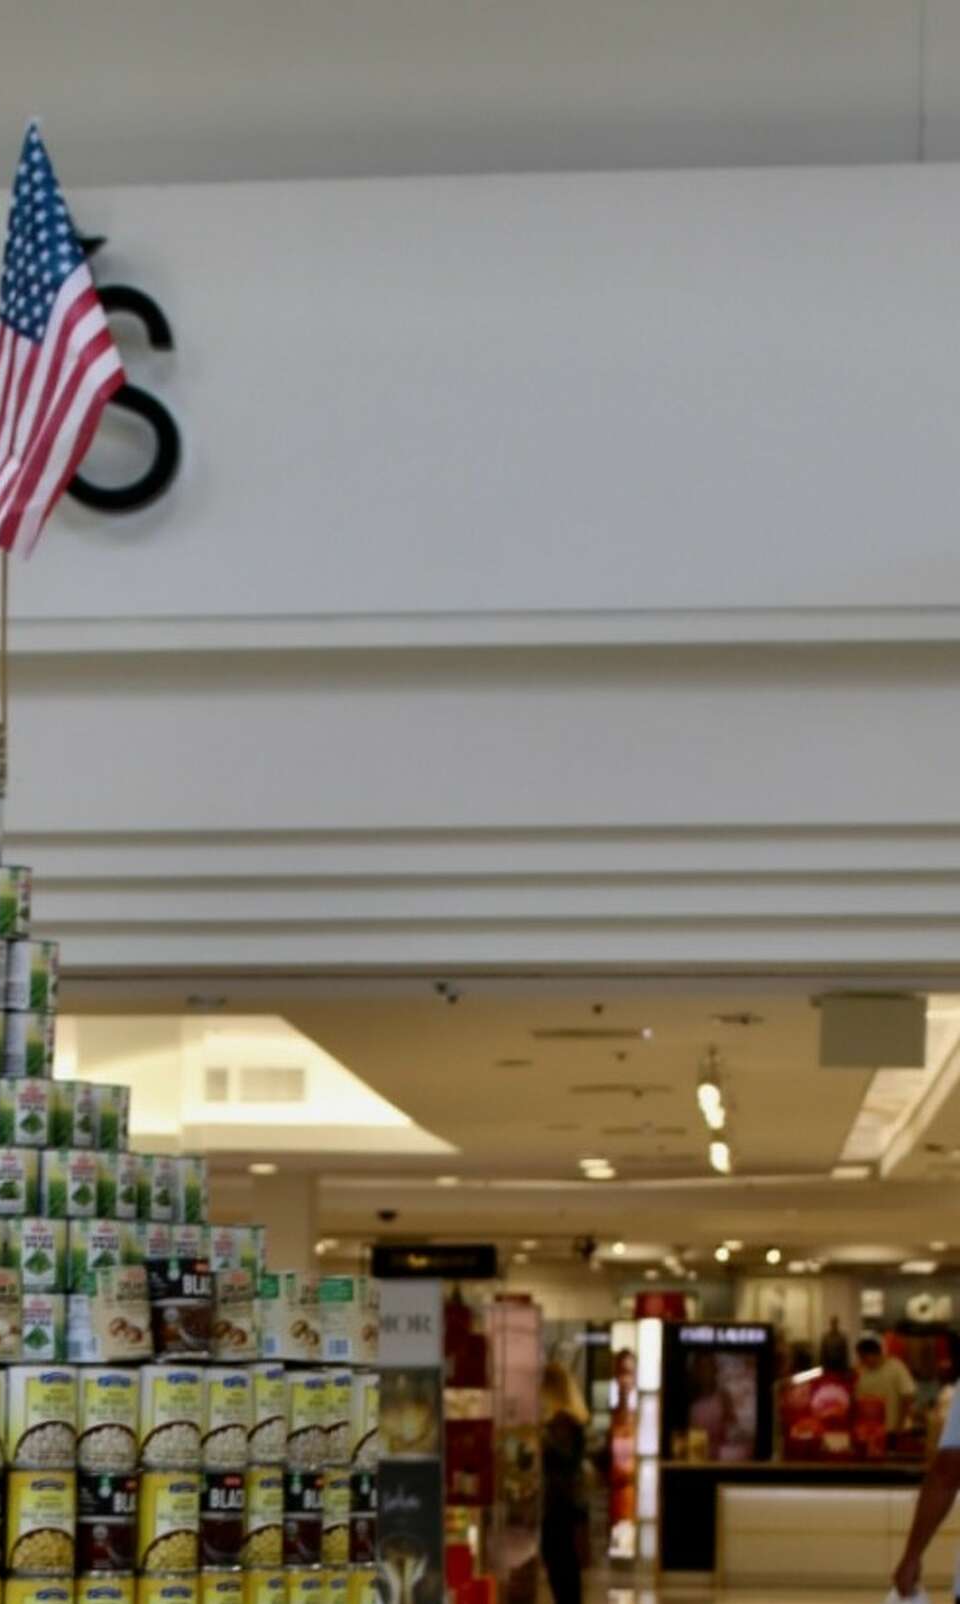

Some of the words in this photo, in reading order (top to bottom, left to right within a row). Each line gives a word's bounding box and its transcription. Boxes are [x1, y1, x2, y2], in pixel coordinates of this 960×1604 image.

[182, 1273, 212, 1296] BLA
[380, 1313, 432, 1335] IOR
[209, 1488, 244, 1510] BLAC
